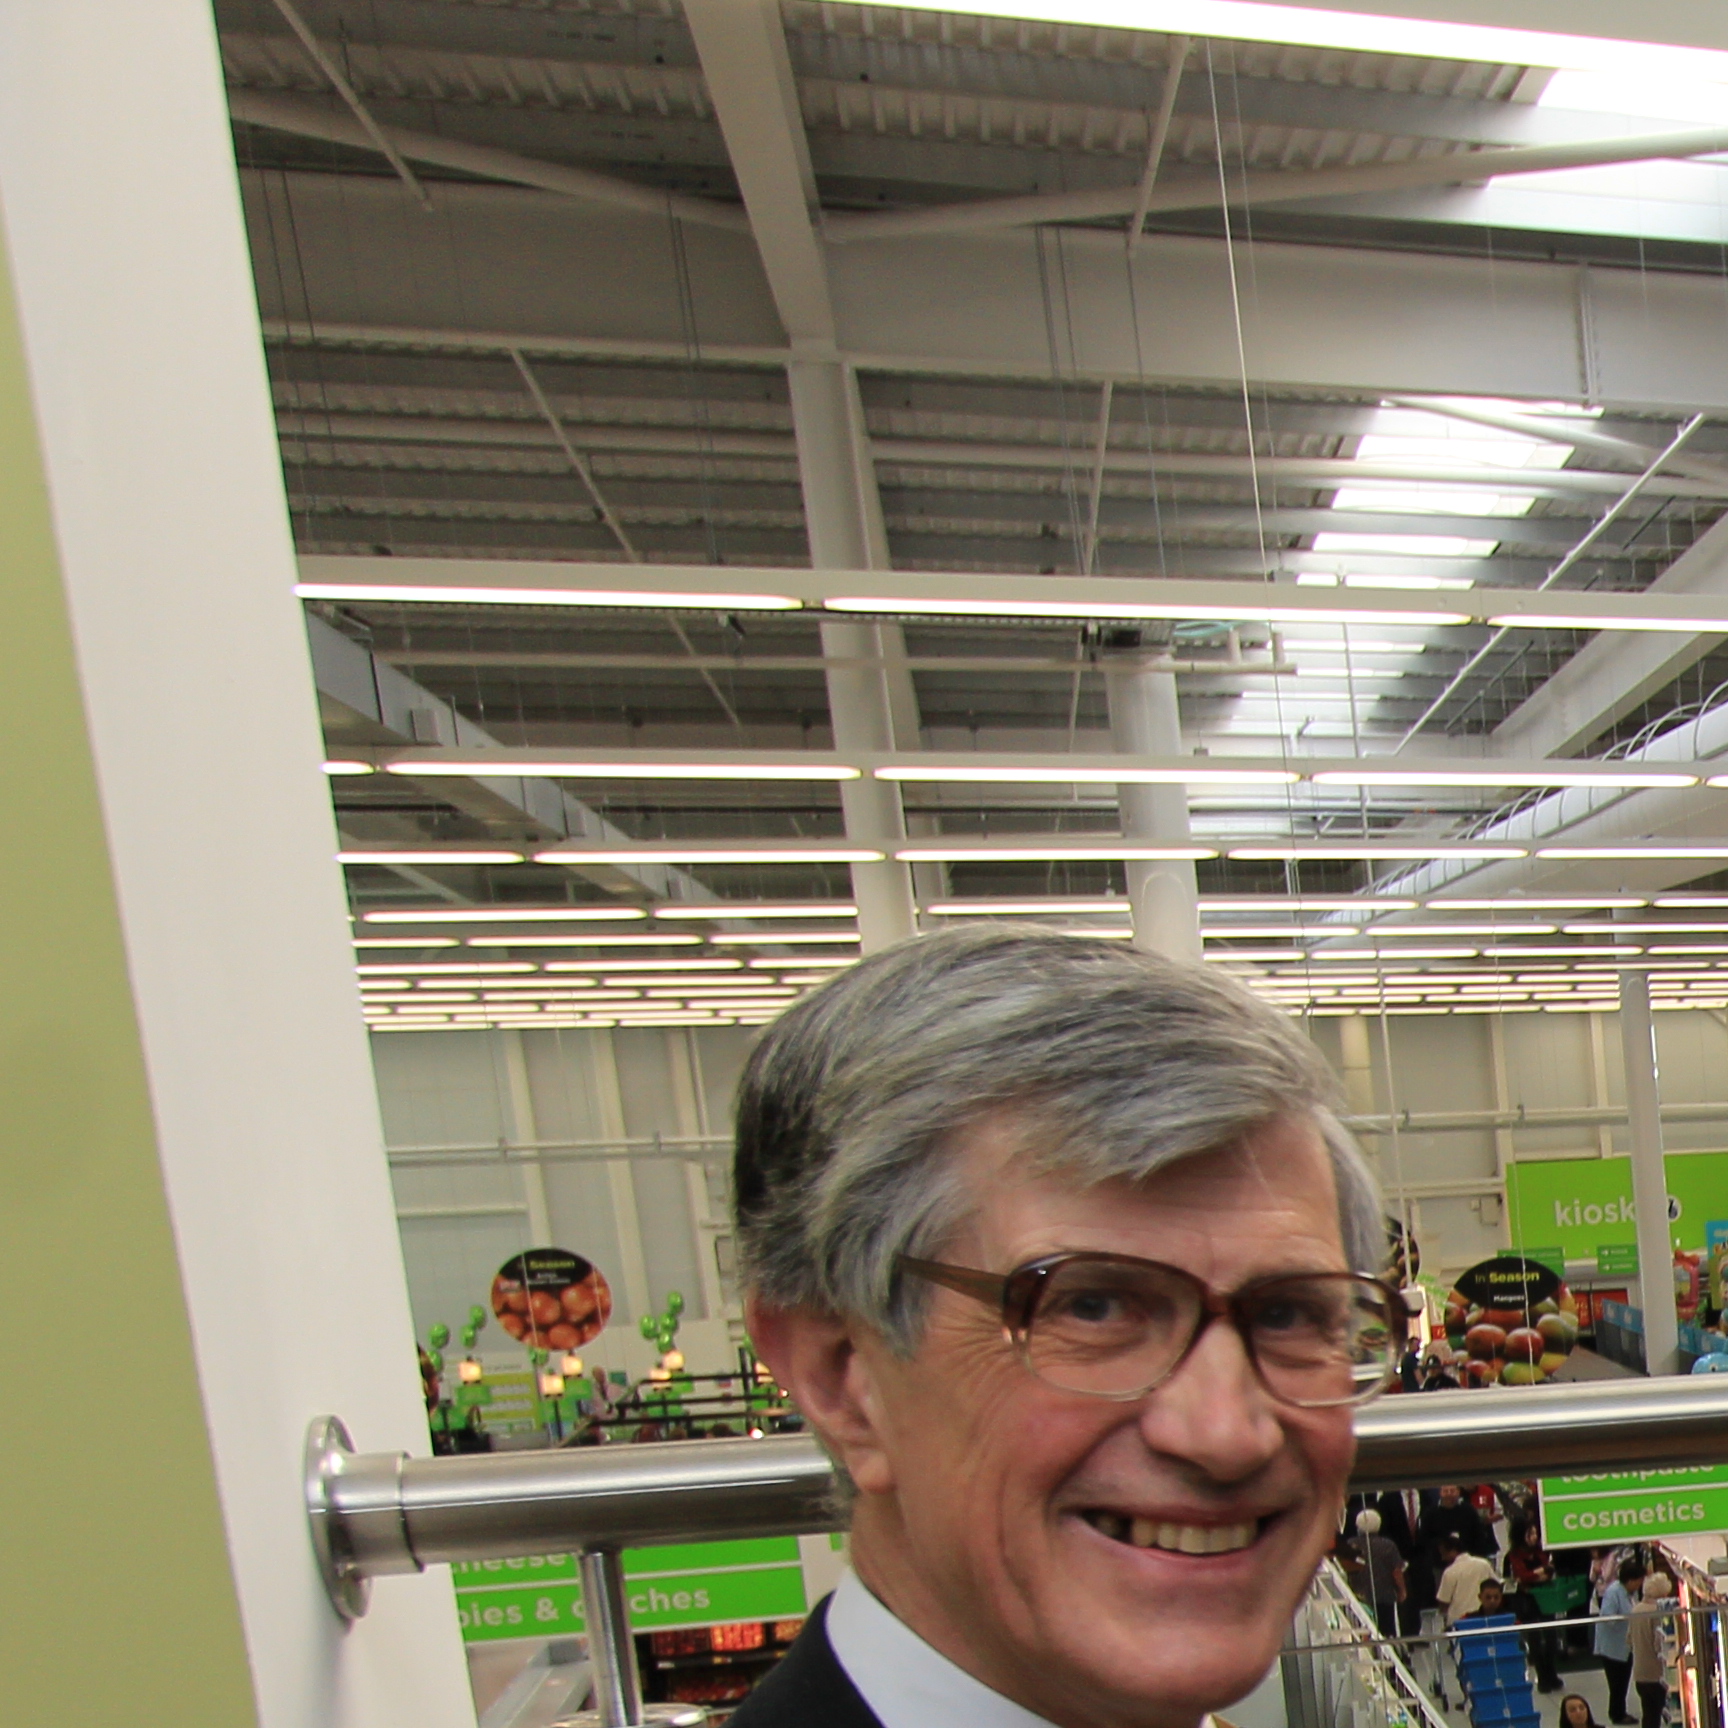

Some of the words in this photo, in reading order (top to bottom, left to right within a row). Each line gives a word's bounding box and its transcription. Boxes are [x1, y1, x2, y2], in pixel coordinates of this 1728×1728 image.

[1554, 1196, 1638, 1228] kiosk
[1488, 1270, 1540, 1284] Season
[1562, 1500, 1706, 1531] cosmetics
[534, 1597, 560, 1623] &
